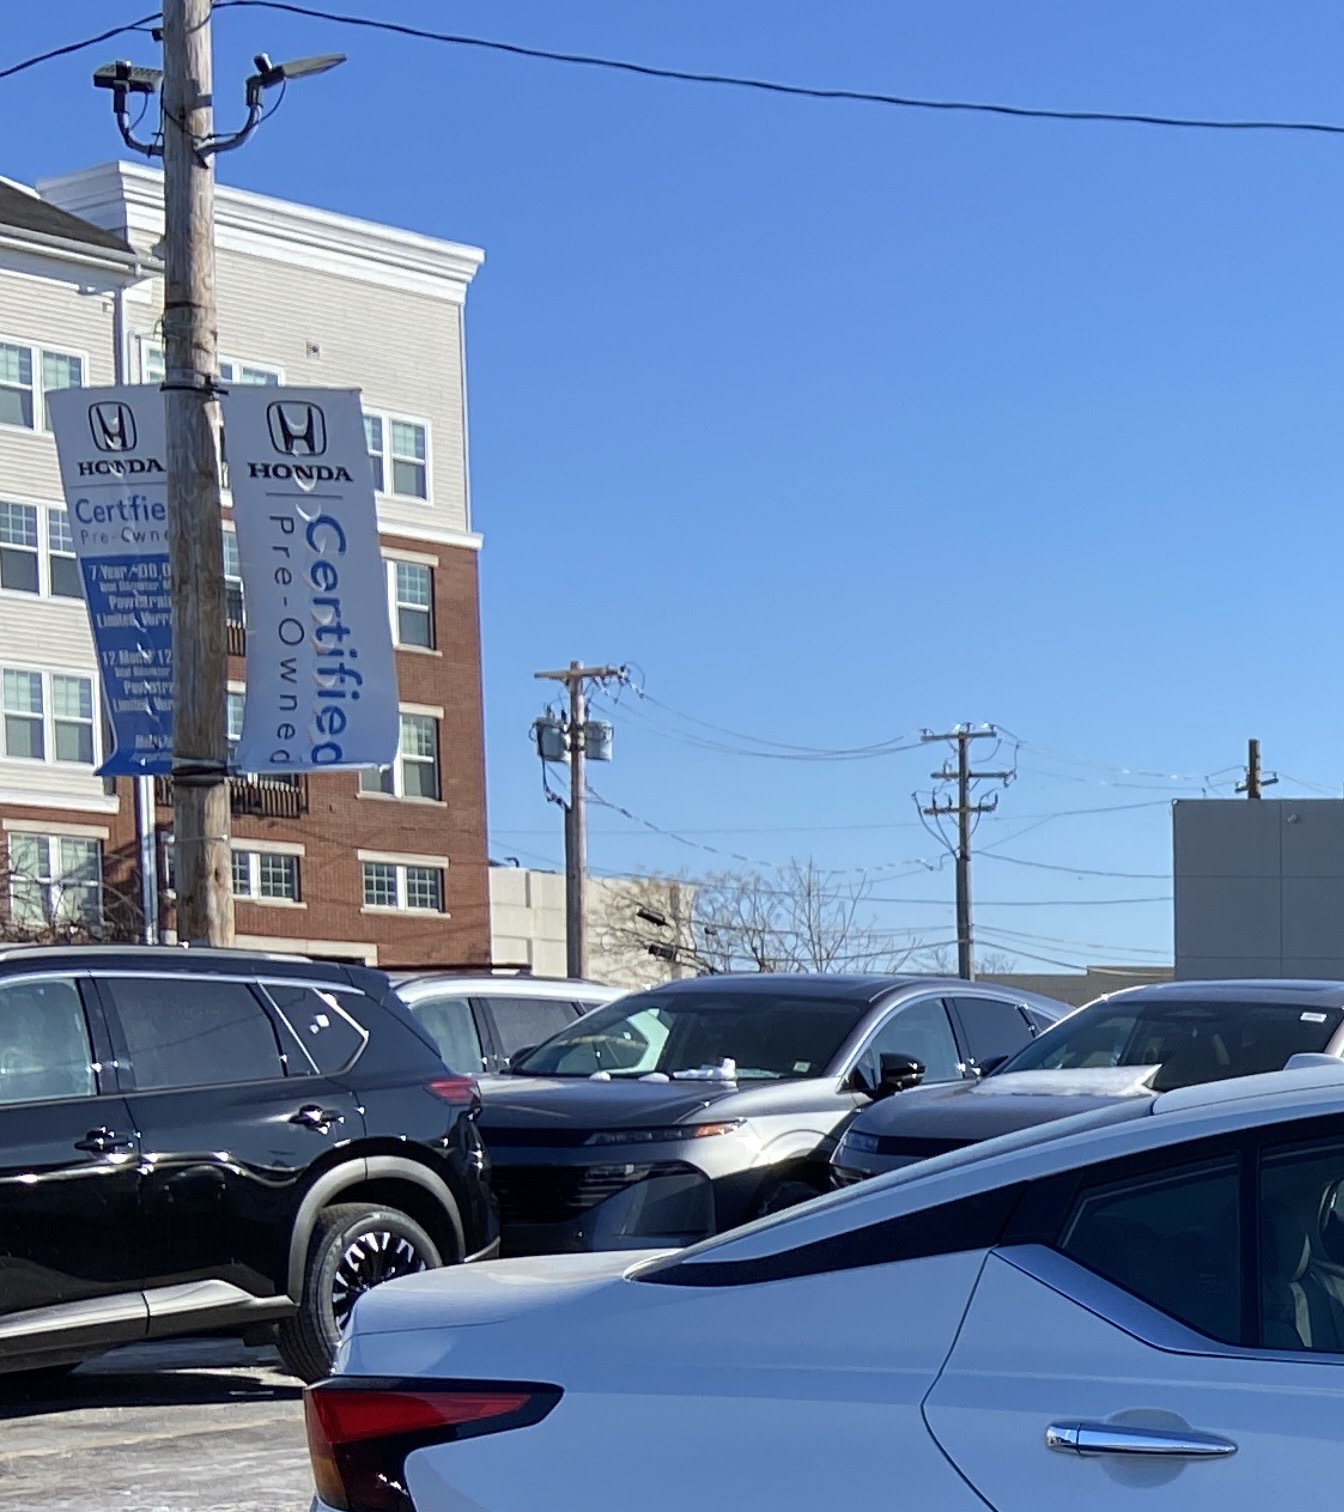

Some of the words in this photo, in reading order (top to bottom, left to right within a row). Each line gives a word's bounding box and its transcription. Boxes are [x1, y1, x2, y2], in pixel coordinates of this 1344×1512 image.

[77, 457, 167, 476] HONDA
[247, 462, 355, 482] HONDA
[75, 494, 167, 525] Certfie
